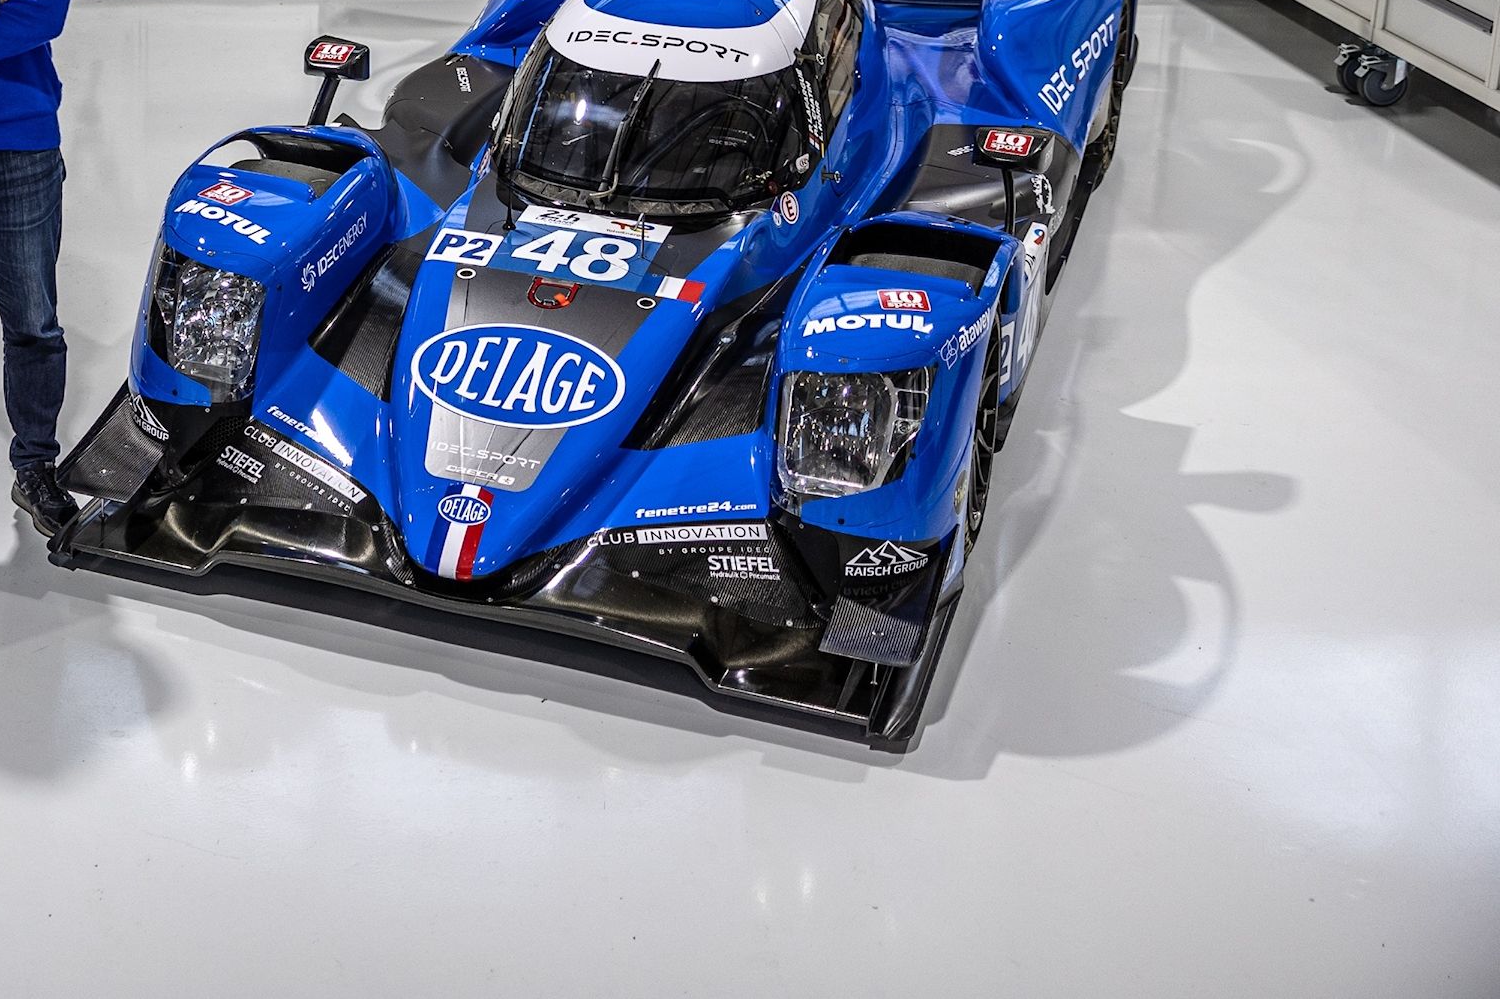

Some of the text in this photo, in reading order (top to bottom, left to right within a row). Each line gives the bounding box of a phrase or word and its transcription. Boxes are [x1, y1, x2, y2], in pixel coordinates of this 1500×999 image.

[315, 52, 345, 61] sport
[319, 43, 350, 55] 10
[990, 142, 1025, 153] sport
[994, 133, 1027, 146] 10
[217, 184, 242, 198] 10
[174, 200, 273, 245] MOTUL
[433, 233, 493, 261] P2
[511, 229, 638, 282] 48
[883, 290, 923, 304] 10
[887, 301, 925, 310] sport
[802, 314, 935, 337] MOTUL
[429, 336, 606, 414] DELAGE
[141, 420, 170, 441] GROUP
[243, 425, 278, 449] CLUB
[220, 445, 267, 480] STIEFEL
[274, 462, 351, 512] BY GROUPE IDEC
[443, 498, 487, 522] DELAGE
[635, 500, 757, 519] fenetre24.com
[587, 525, 761, 548] CLUB INNOVATION
[681, 546, 733, 555] GROUPE
[740, 546, 771, 554] IDEC
[707, 555, 780, 573] STIEFEL
[844, 557, 929, 577] RAISCH GROUP
[709, 571, 781, 581] Hydraulik Pneumatik
